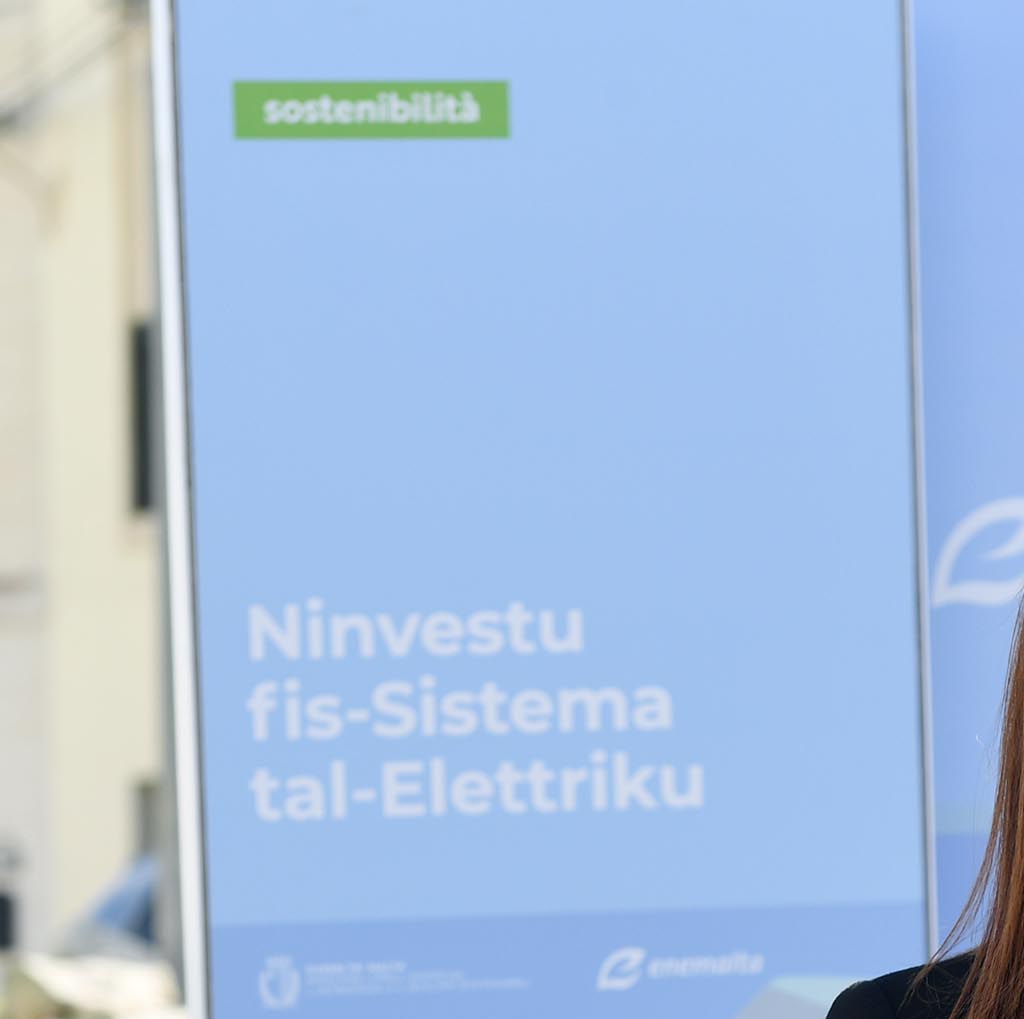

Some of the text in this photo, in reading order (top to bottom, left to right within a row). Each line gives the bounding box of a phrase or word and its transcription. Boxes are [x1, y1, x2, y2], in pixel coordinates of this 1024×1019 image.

[263, 92, 481, 124] sostenibilità
[248, 598, 584, 661] Ninvestu
[247, 674, 673, 741] fis-Sistema
[249, 750, 704, 821] tal-Elettriku
[649, 951, 765, 978] enemalta
